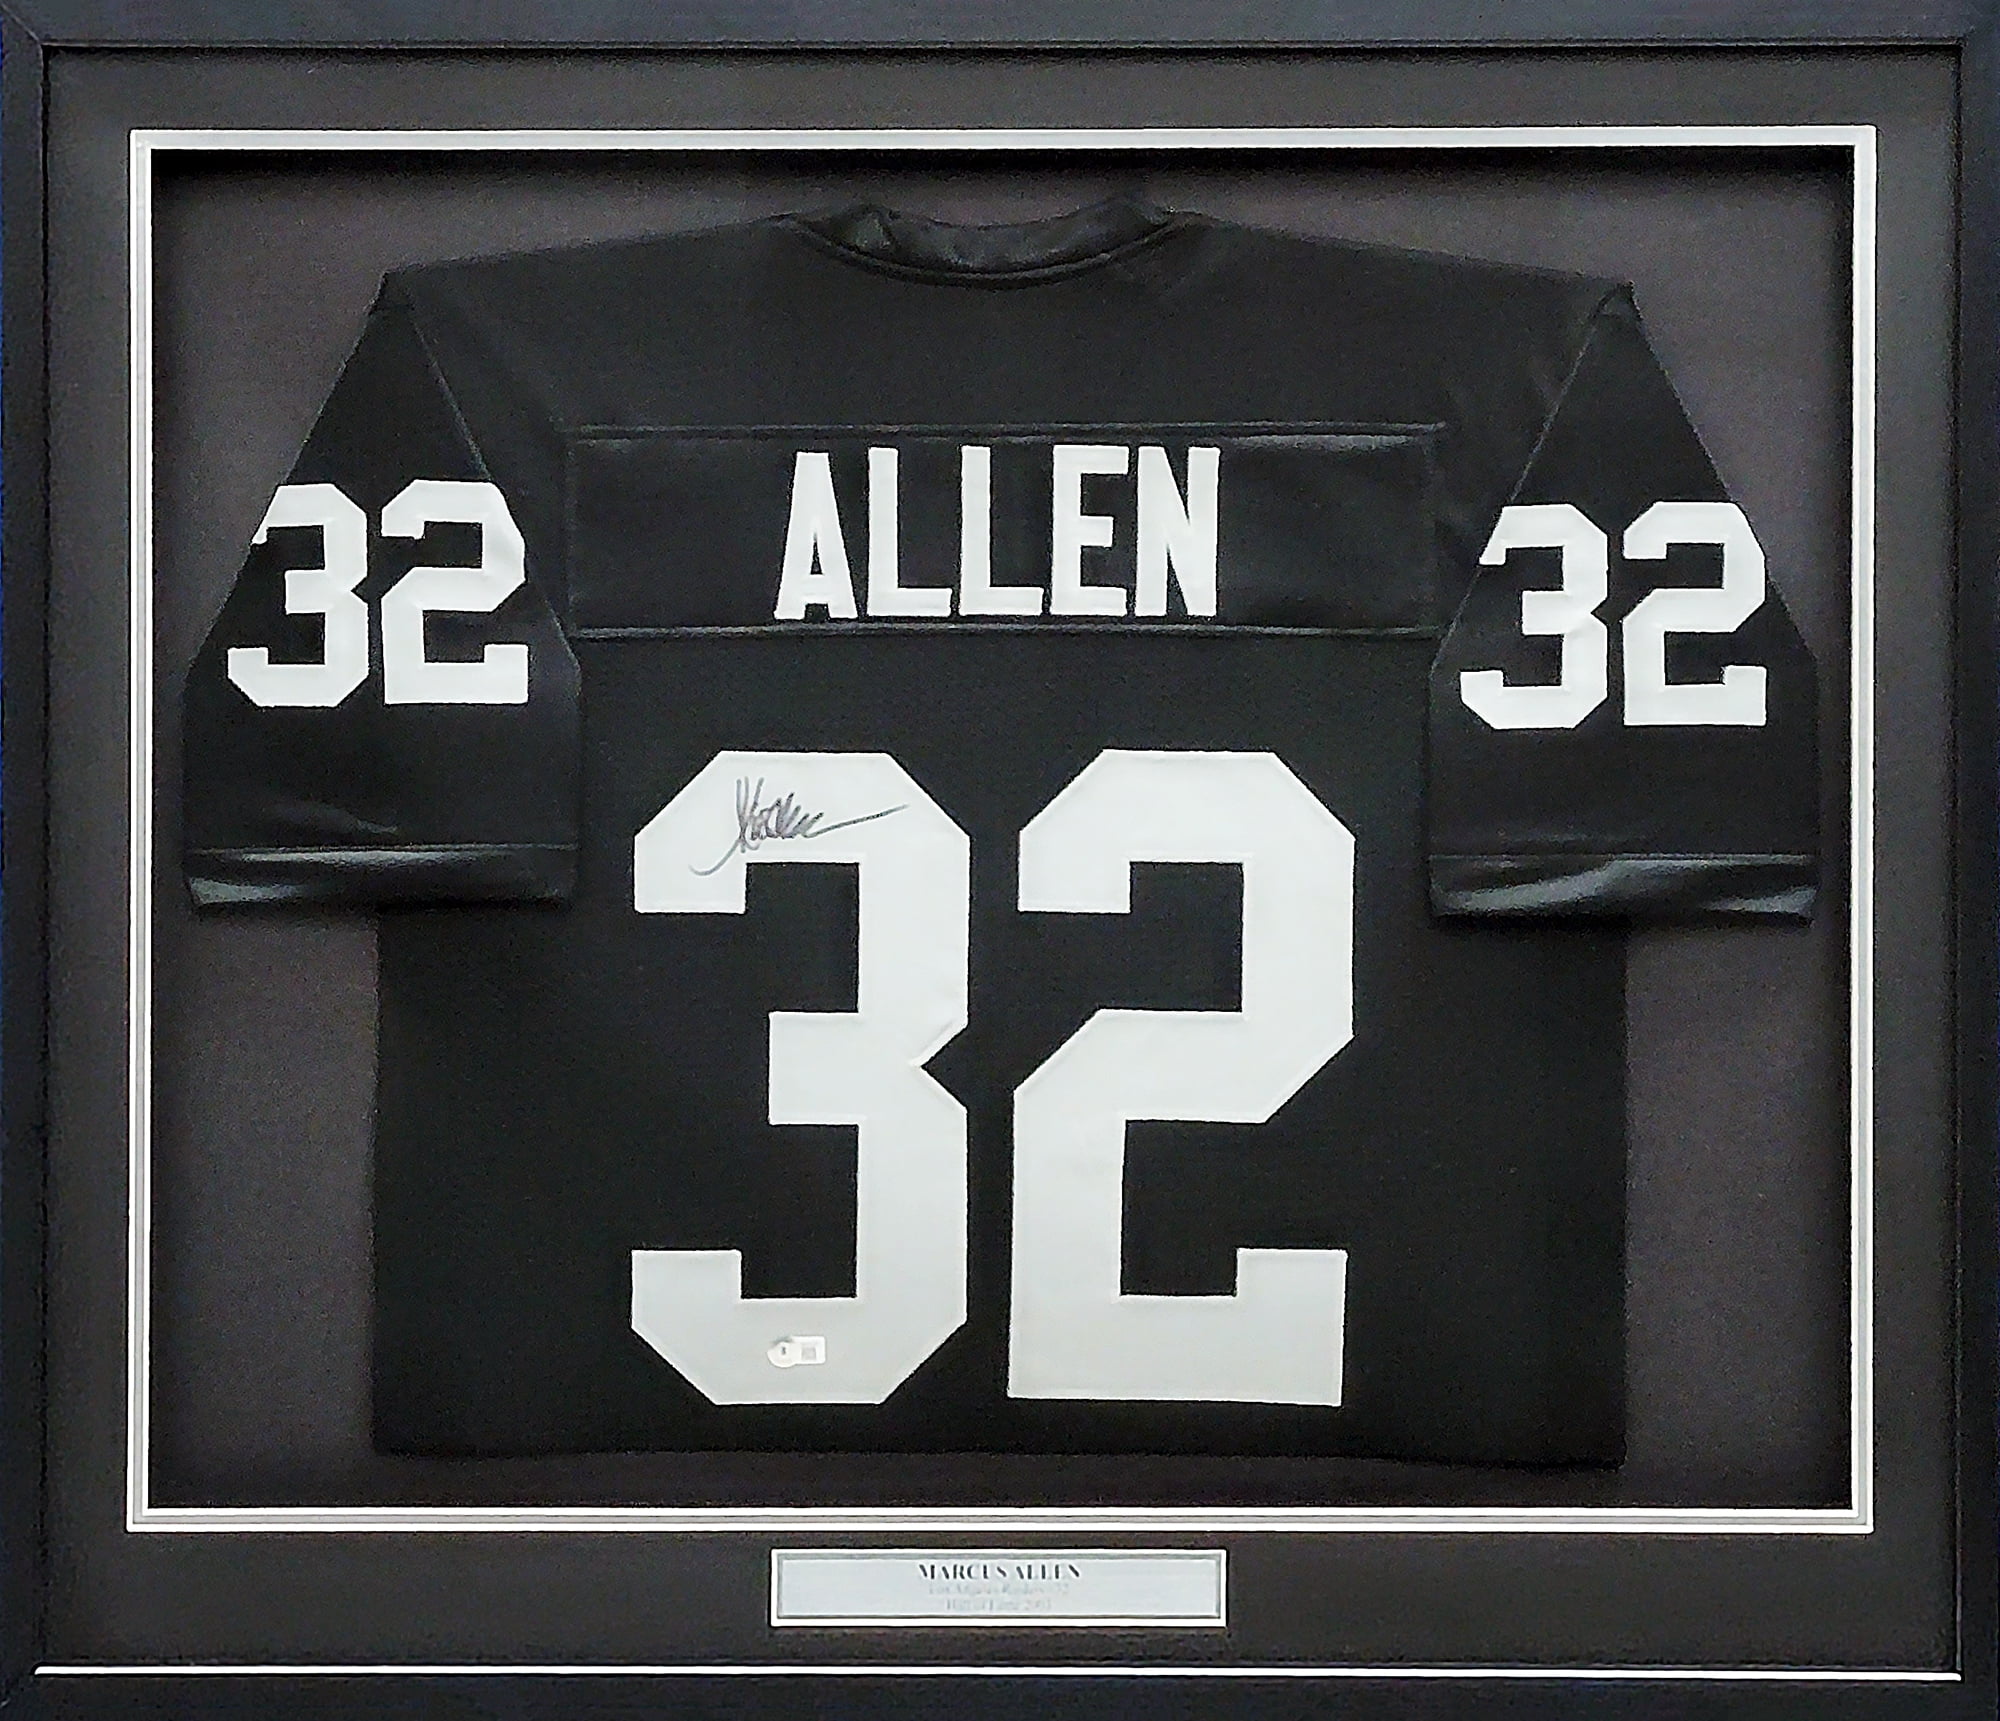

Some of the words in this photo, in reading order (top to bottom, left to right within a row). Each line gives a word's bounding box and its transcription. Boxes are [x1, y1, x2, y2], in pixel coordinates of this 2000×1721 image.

[227, 480, 529, 707] 32
[774, 445, 1220, 621] ALLEN
[1459, 501, 1767, 729] 32
[631, 748, 1357, 1406] 32
